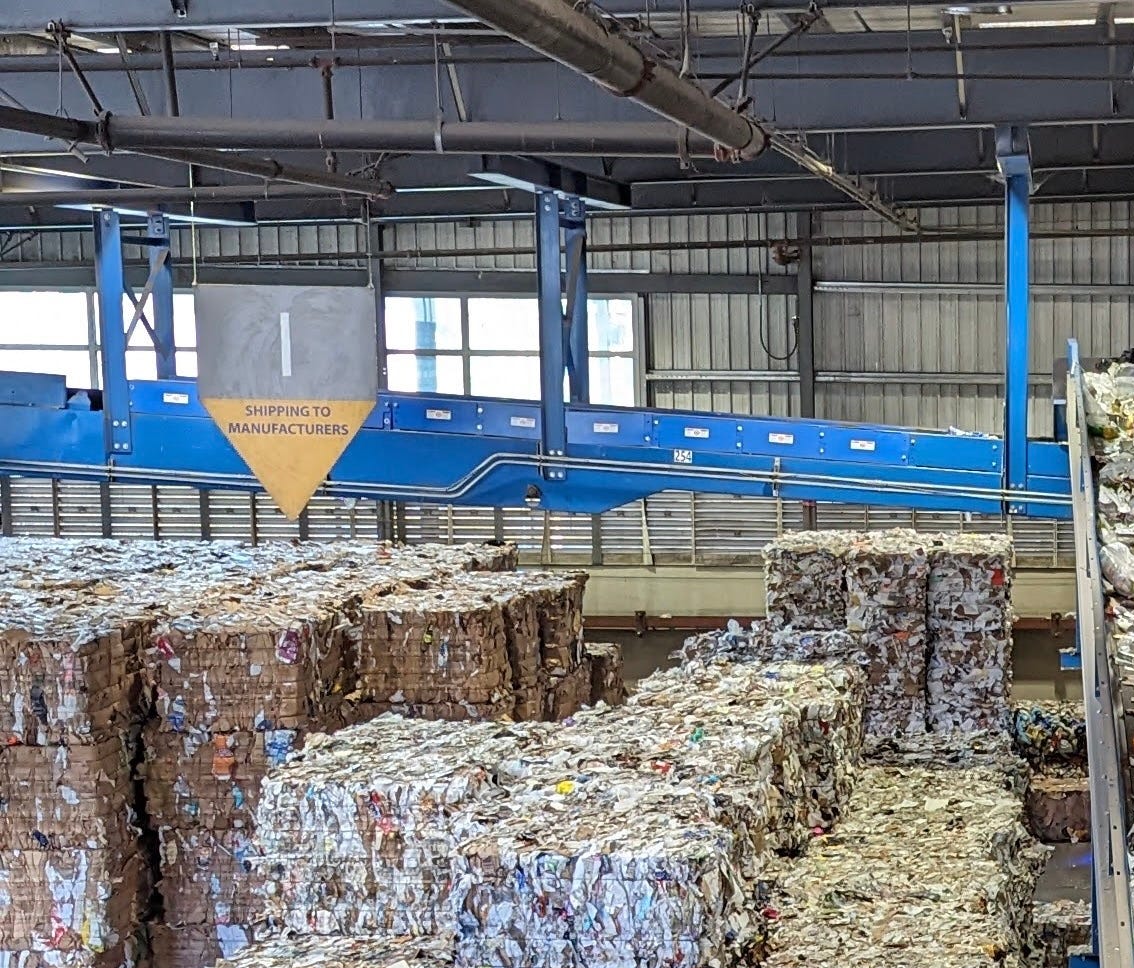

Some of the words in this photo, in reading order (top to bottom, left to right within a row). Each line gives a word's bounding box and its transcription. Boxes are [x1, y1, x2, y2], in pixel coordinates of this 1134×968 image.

[245, 405, 310, 418] SHIPPING
[313, 406, 331, 417] TO
[228, 422, 349, 436] MANUFACTURERS
[674, 450, 692, 463] 254
